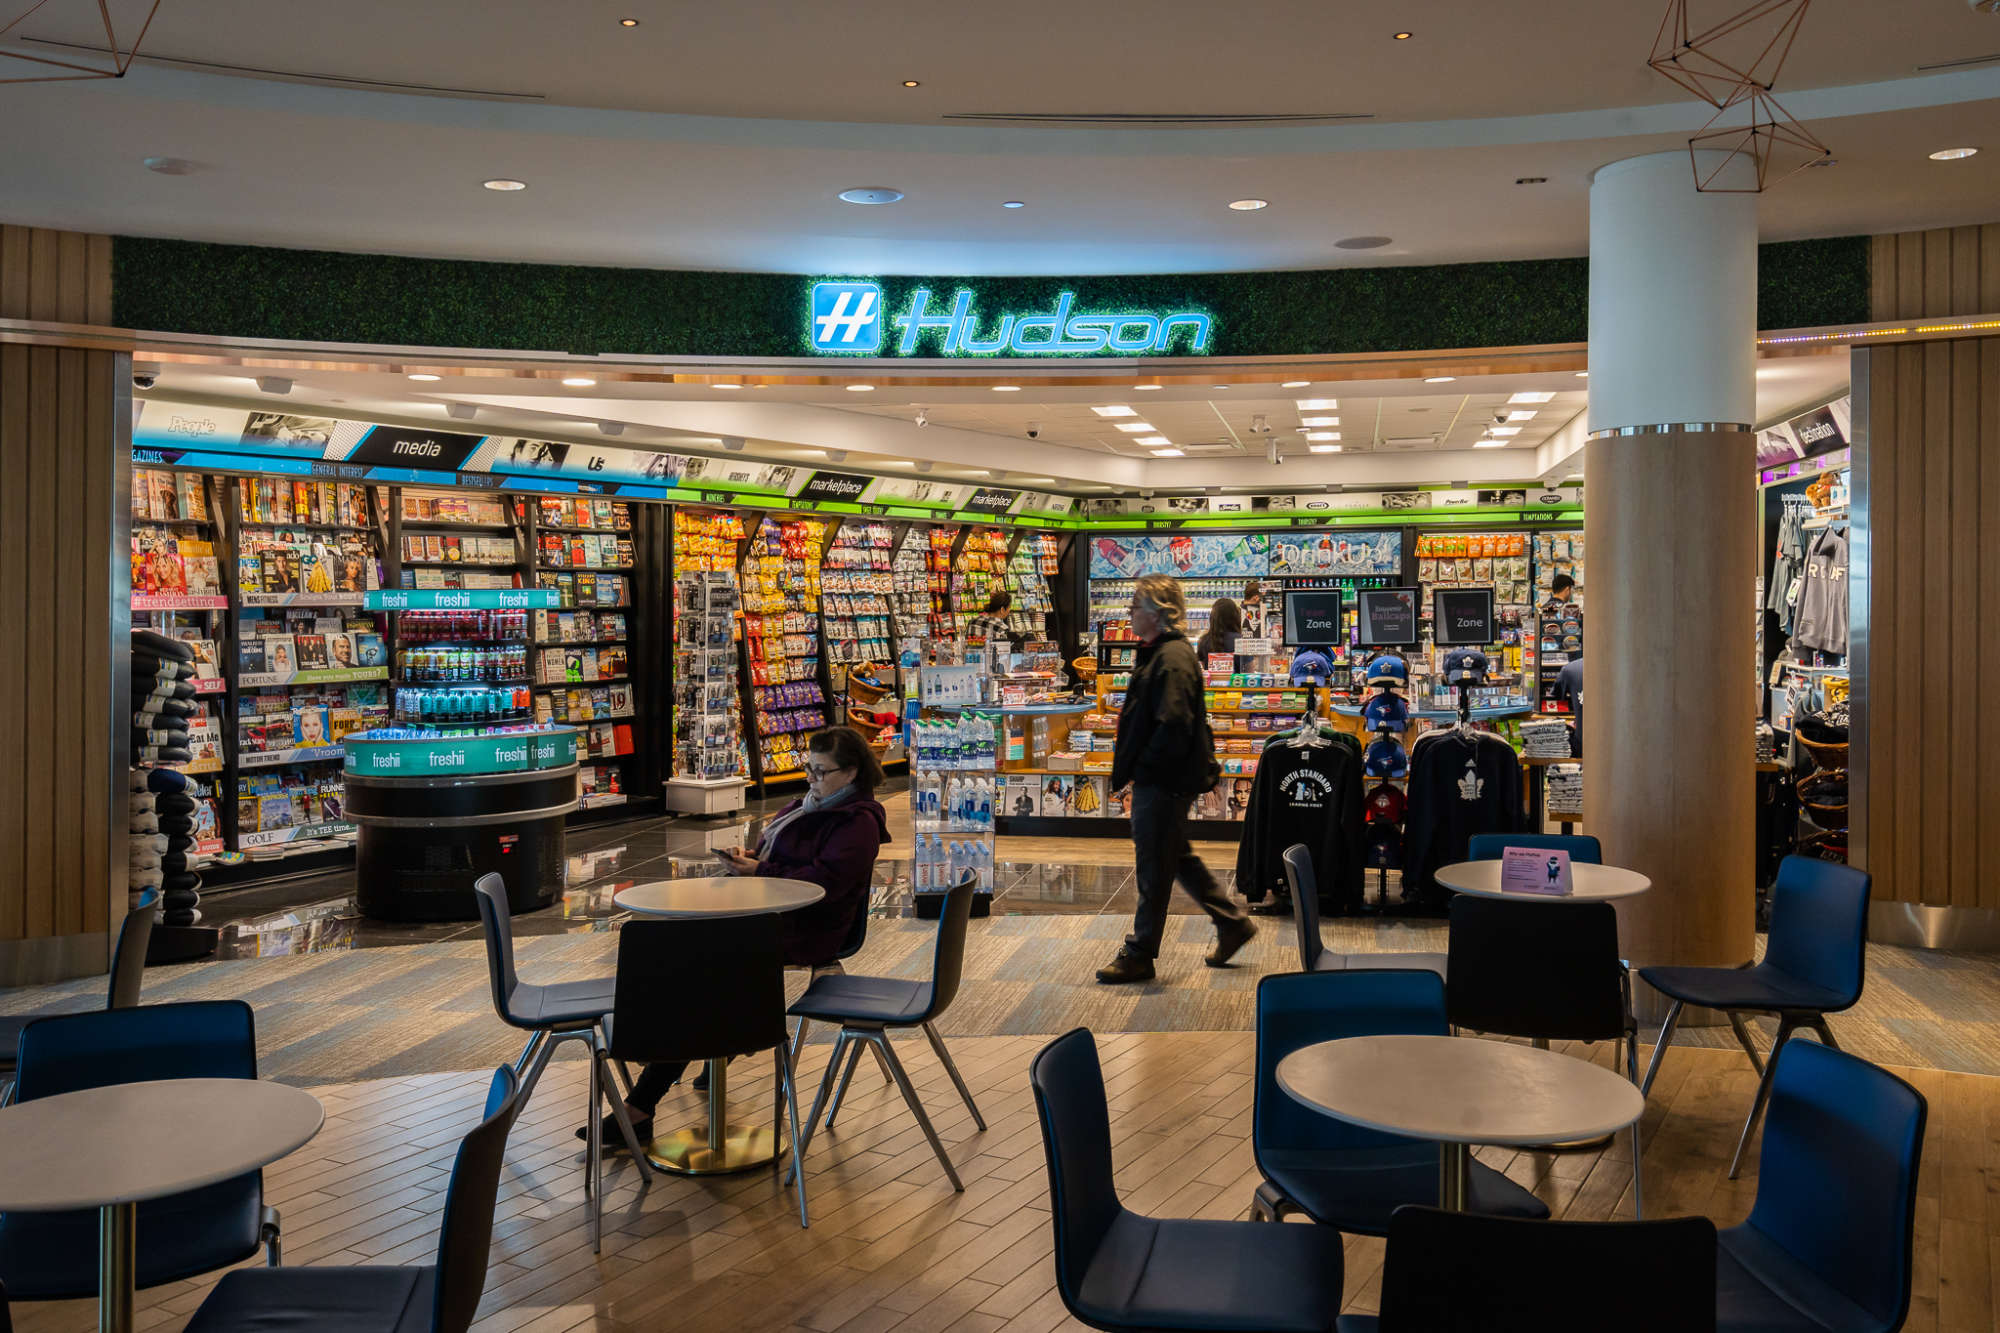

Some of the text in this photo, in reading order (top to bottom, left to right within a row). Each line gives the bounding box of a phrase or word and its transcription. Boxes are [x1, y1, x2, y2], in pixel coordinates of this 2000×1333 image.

[896, 289, 1210, 352] Hudson
[393, 440, 442, 457] media
[132, 450, 163, 464] GAZINES
[312, 464, 336, 476] GENERAL
[809, 478, 862, 495] marketplace
[972, 493, 1012, 509] marketplace
[301, 555, 318, 565] GQ
[134, 595, 215, 609] #trendsetting
[382, 593, 407, 608] freshii
[435, 592, 470, 607] freshii
[499, 592, 529, 606] freshii
[1306, 619, 1332, 630] Zone
[1457, 618, 1484, 628] Zone
[242, 676, 279, 685] FORTUNE
[353, 669, 381, 679] YOURS?
[204, 681, 221, 691] SELF
[611, 692, 626, 711] 19
[189, 732, 219, 744] Eat Me
[429, 750, 464, 767] freshii
[496, 746, 527, 764] freshii
[531, 743, 555, 760] freshii
[246, 754, 280, 764] MOTOR TREND
[373, 753, 400, 768] freshii
[1279, 769, 1332, 793] NORTH STANDARD
[320, 783, 345, 794] RUNNE
[319, 826, 332, 835] TEE
[247, 832, 275, 846] GOLF
